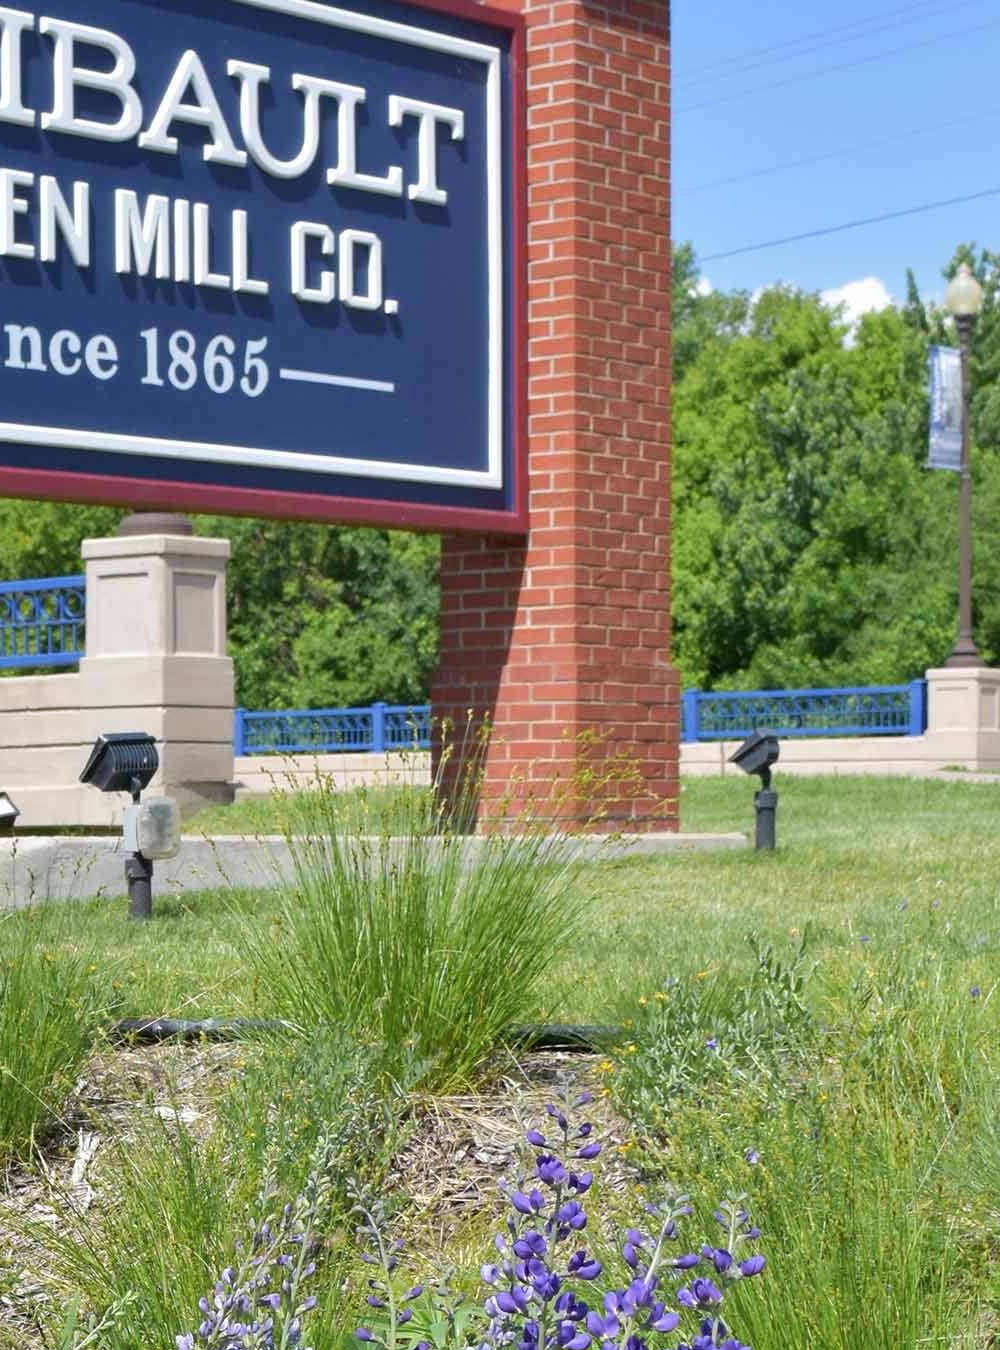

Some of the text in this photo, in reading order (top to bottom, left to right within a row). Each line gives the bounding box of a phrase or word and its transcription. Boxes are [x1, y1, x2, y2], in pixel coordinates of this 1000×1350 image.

[114, 188, 269, 293] MILL
[290, 220, 399, 314] CO.
[140, 328, 270, 397] 1865
